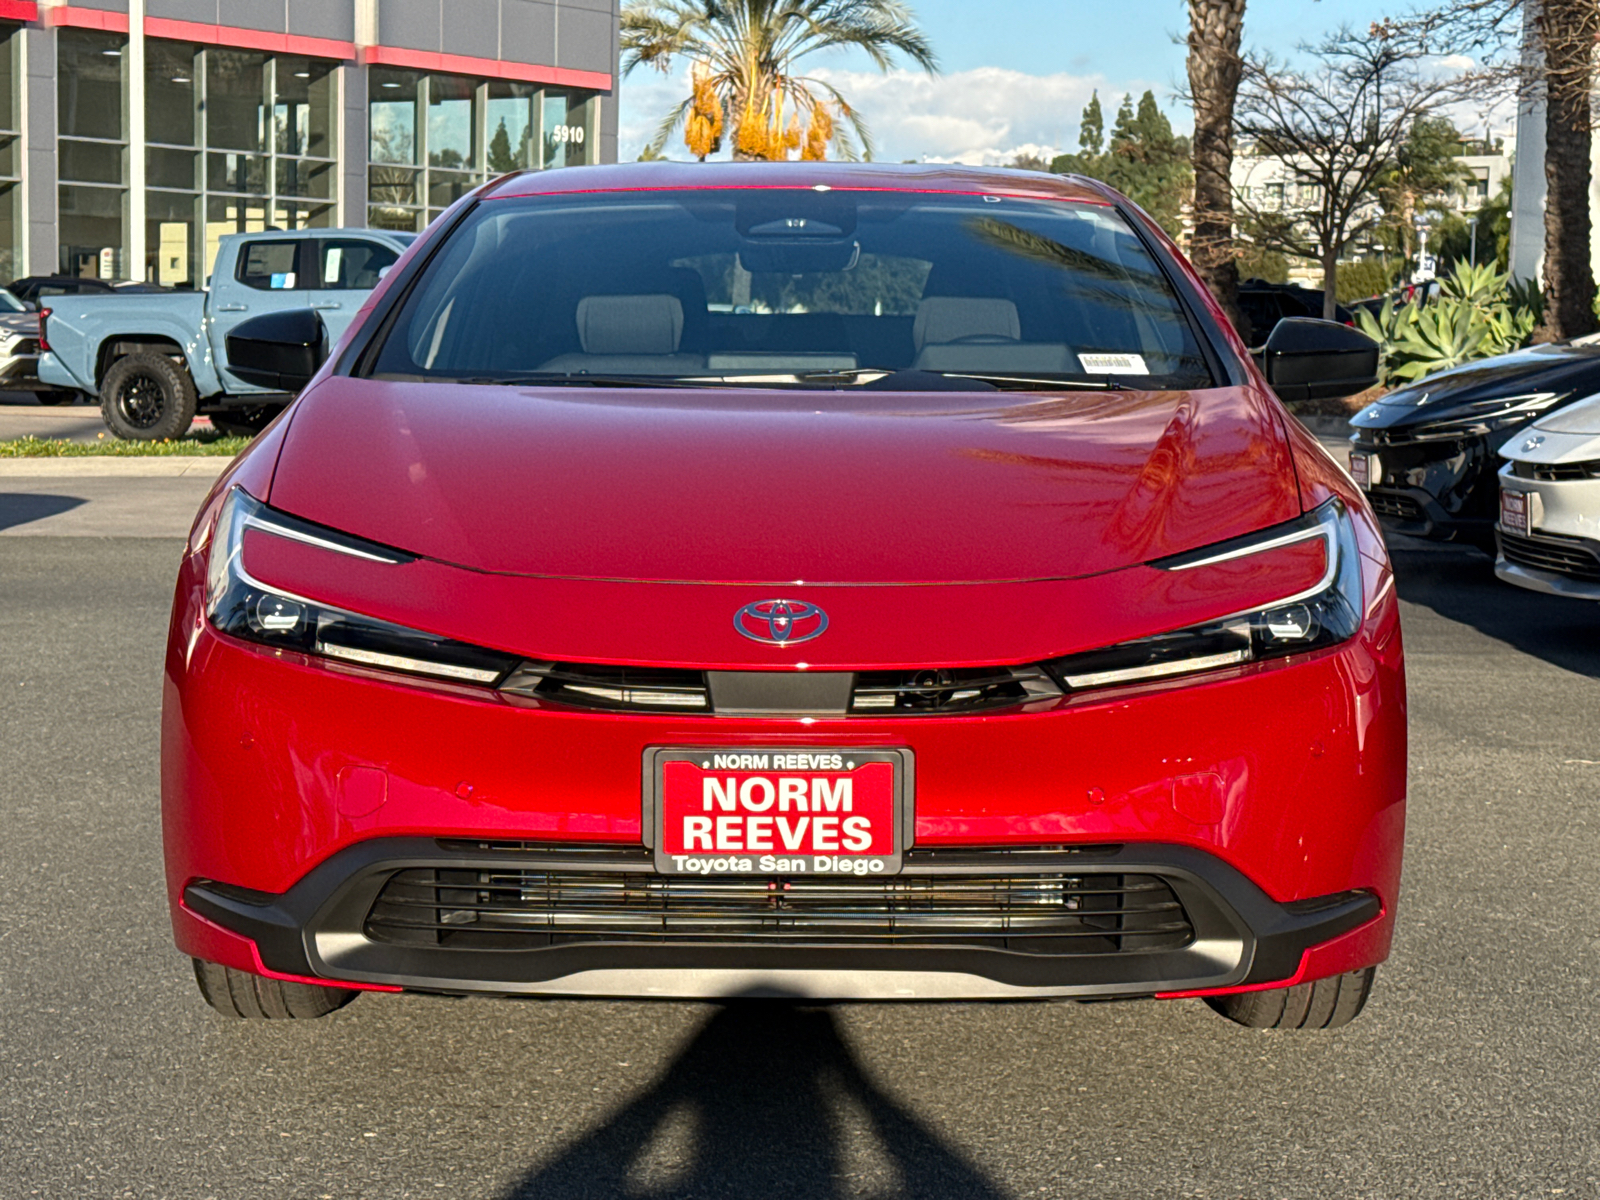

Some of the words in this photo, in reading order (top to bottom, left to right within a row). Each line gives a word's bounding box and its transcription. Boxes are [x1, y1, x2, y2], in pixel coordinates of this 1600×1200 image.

[553, 125, 584, 143] 5910
[1504, 496, 1524, 513] NORM
[1503, 510, 1526, 529] REEVES
[714, 754, 768, 770] NORM
[773, 754, 842, 770] REEVES
[703, 777, 853, 812] NORM
[683, 816, 873, 851] REEVES
[671, 855, 752, 875] Toyota
[759, 855, 806, 872] San
[813, 855, 884, 876] Diego
